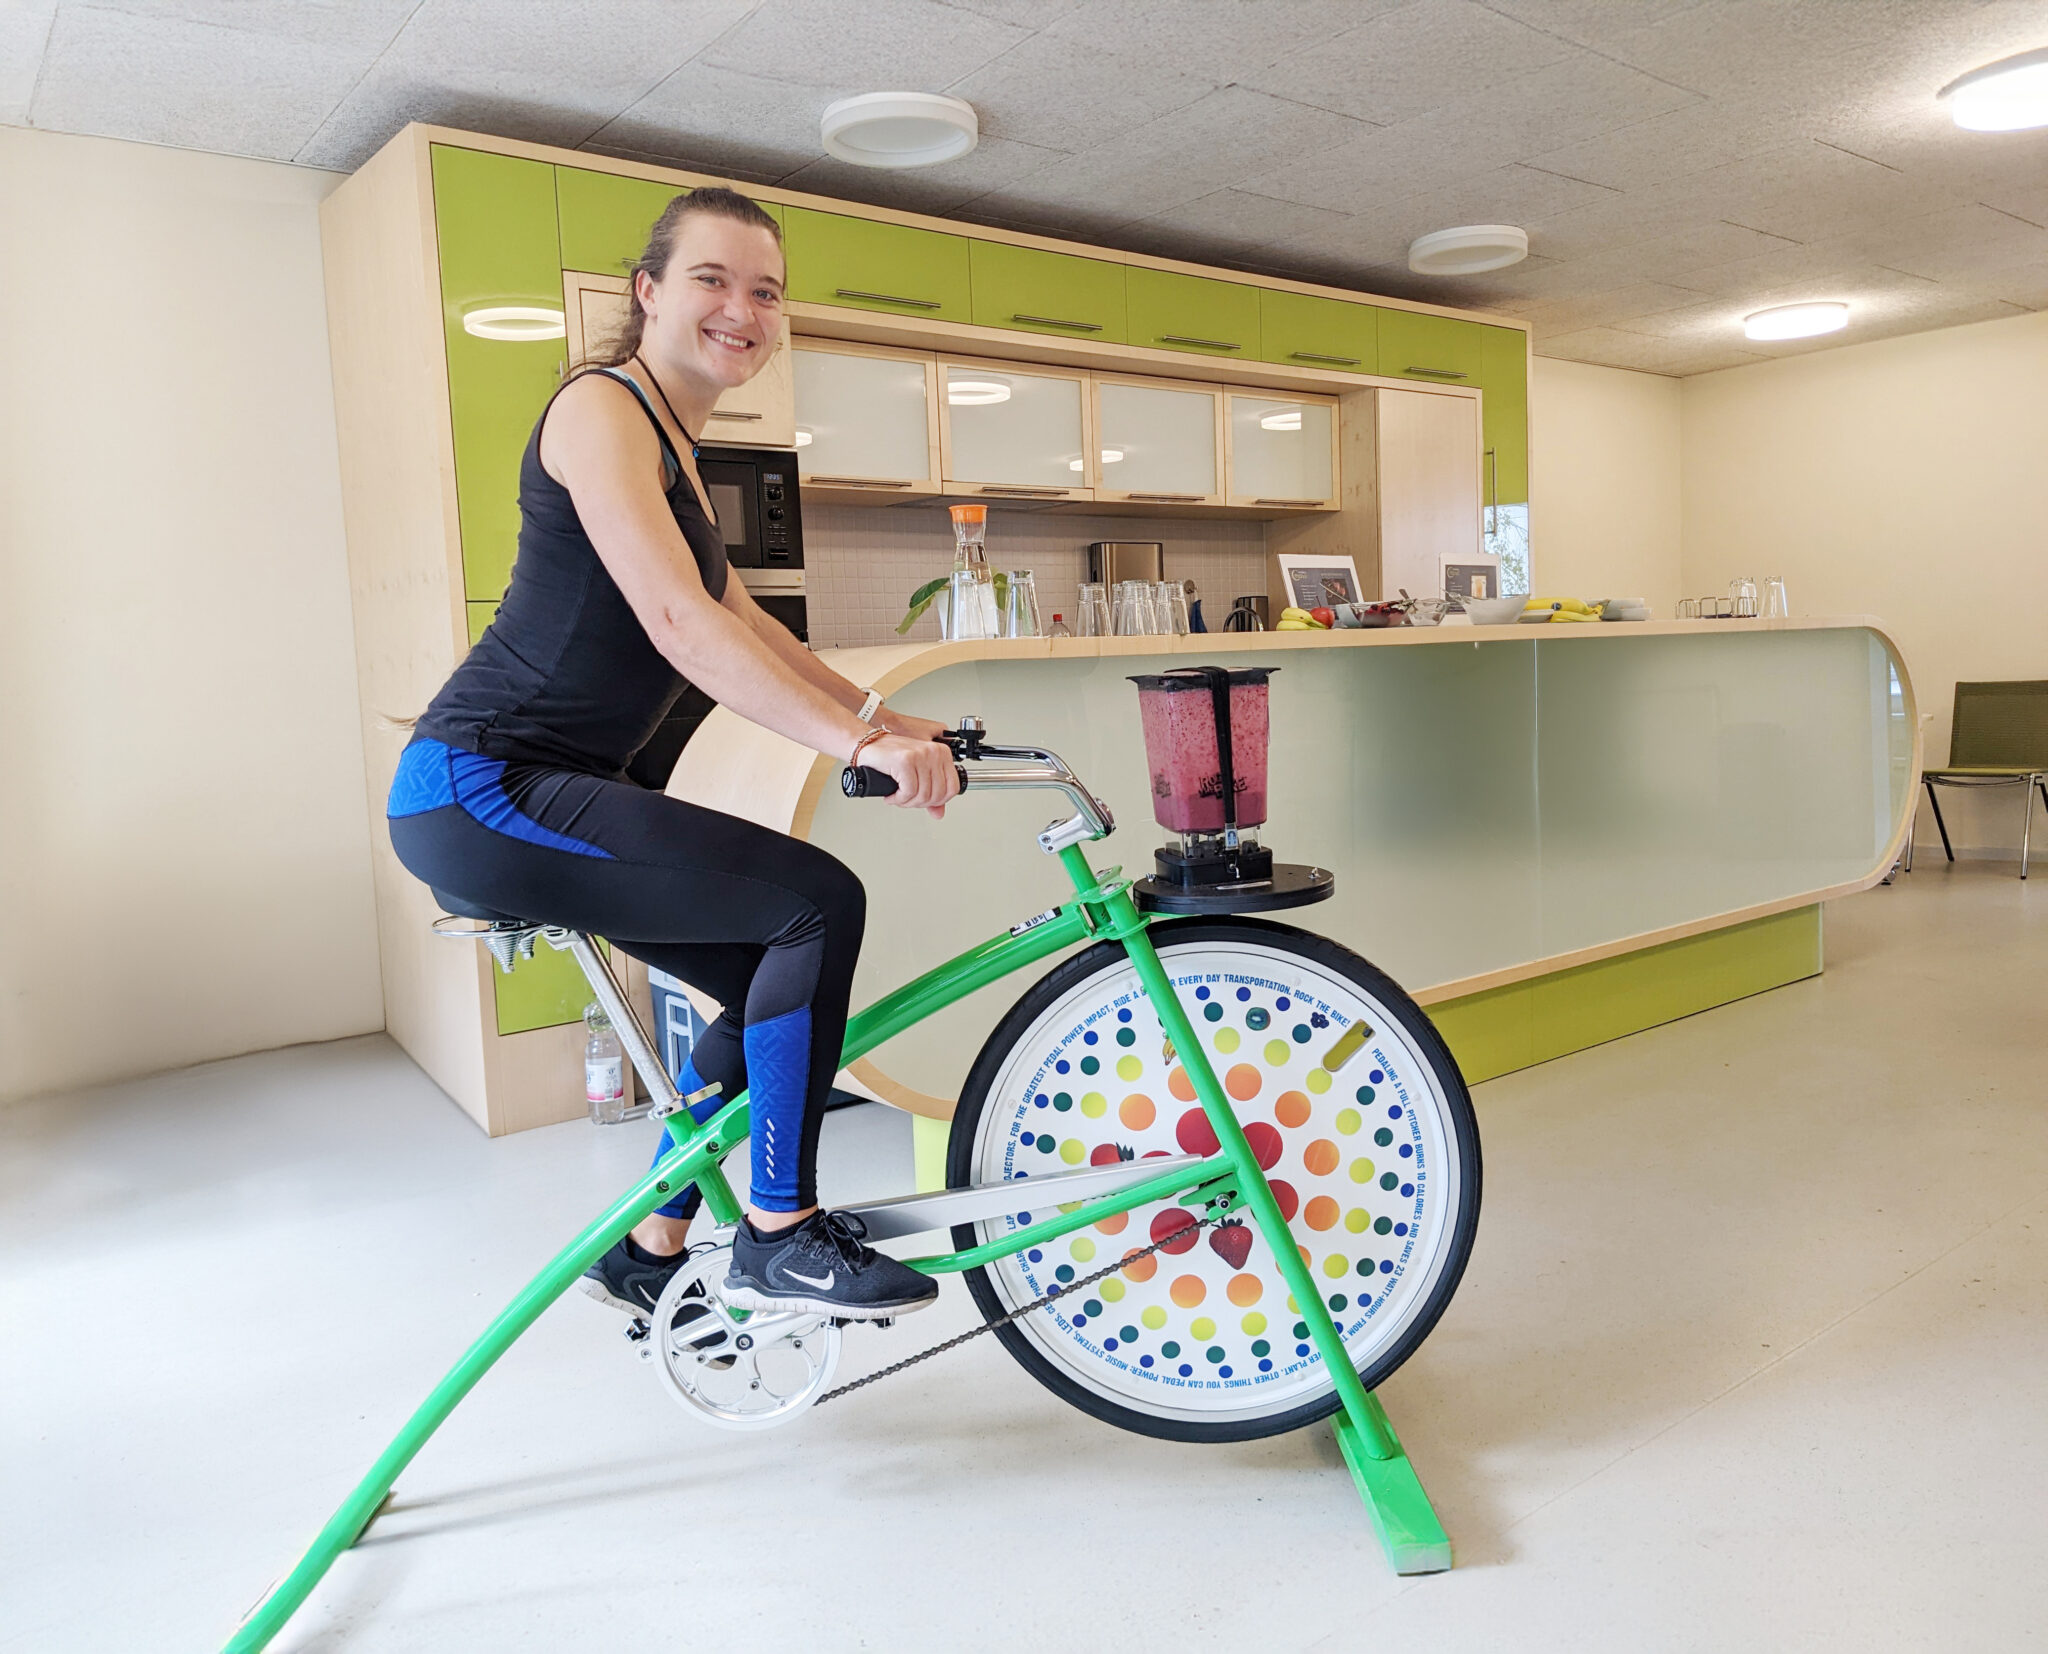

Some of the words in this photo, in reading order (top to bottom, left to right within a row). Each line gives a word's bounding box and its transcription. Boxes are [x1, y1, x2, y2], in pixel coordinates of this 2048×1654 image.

[1178, 974, 1203, 986] EVERY
[1205, 974, 1220, 983] DAY
[1224, 974, 1291, 995] TRANSPORTATION.
[1113, 993, 1132, 1008] RIDE
[1132, 990, 1139, 999] A
[1293, 990, 1314, 1004] ROCK
[1083, 1003, 1113, 1027] IMPACT,
[1315, 1000, 1331, 1014] THE
[1330, 1010, 1350, 1027] BIKE!
[1061, 1023, 1085, 1046] POWER
[1043, 1046, 1063, 1067] PEDAL
[1371, 1048, 1398, 1082] PEDALING
[1022, 1067, 1046, 1104] GREATEST
[1397, 1089, 1410, 1108] FULL
[1015, 1105, 1027, 1119] THE
[1010, 1121, 1021, 1137] FOR
[1406, 1109, 1421, 1141] PITCHER
[1414, 1144, 1425, 1169] BURNS
[1417, 1171, 1425, 1180] 10
[1413, 1184, 1425, 1220] CALORIES
[1408, 1222, 1420, 1238] AND
[1399, 1240, 1414, 1263] SAVES
[1393, 1264, 1404, 1276] 23
[1026, 1273, 1043, 1296] PHONE
[1364, 1277, 1397, 1319] WATT-HOURS
[1347, 1317, 1367, 1336] FROM
[1072, 1330, 1105, 1358] SYSTEMS,
[1105, 1353, 1128, 1371] MUSIC
[1280, 1358, 1308, 1376] PLANT.
[1130, 1365, 1159, 1382] POWER:
[1161, 1375, 1185, 1387] PEDAL
[1254, 1370, 1280, 1384] OTHER
[1187, 1380, 1203, 1389] CAN
[1206, 1381, 1220, 1389] YOU
[1224, 1377, 1252, 1388] THINGS
